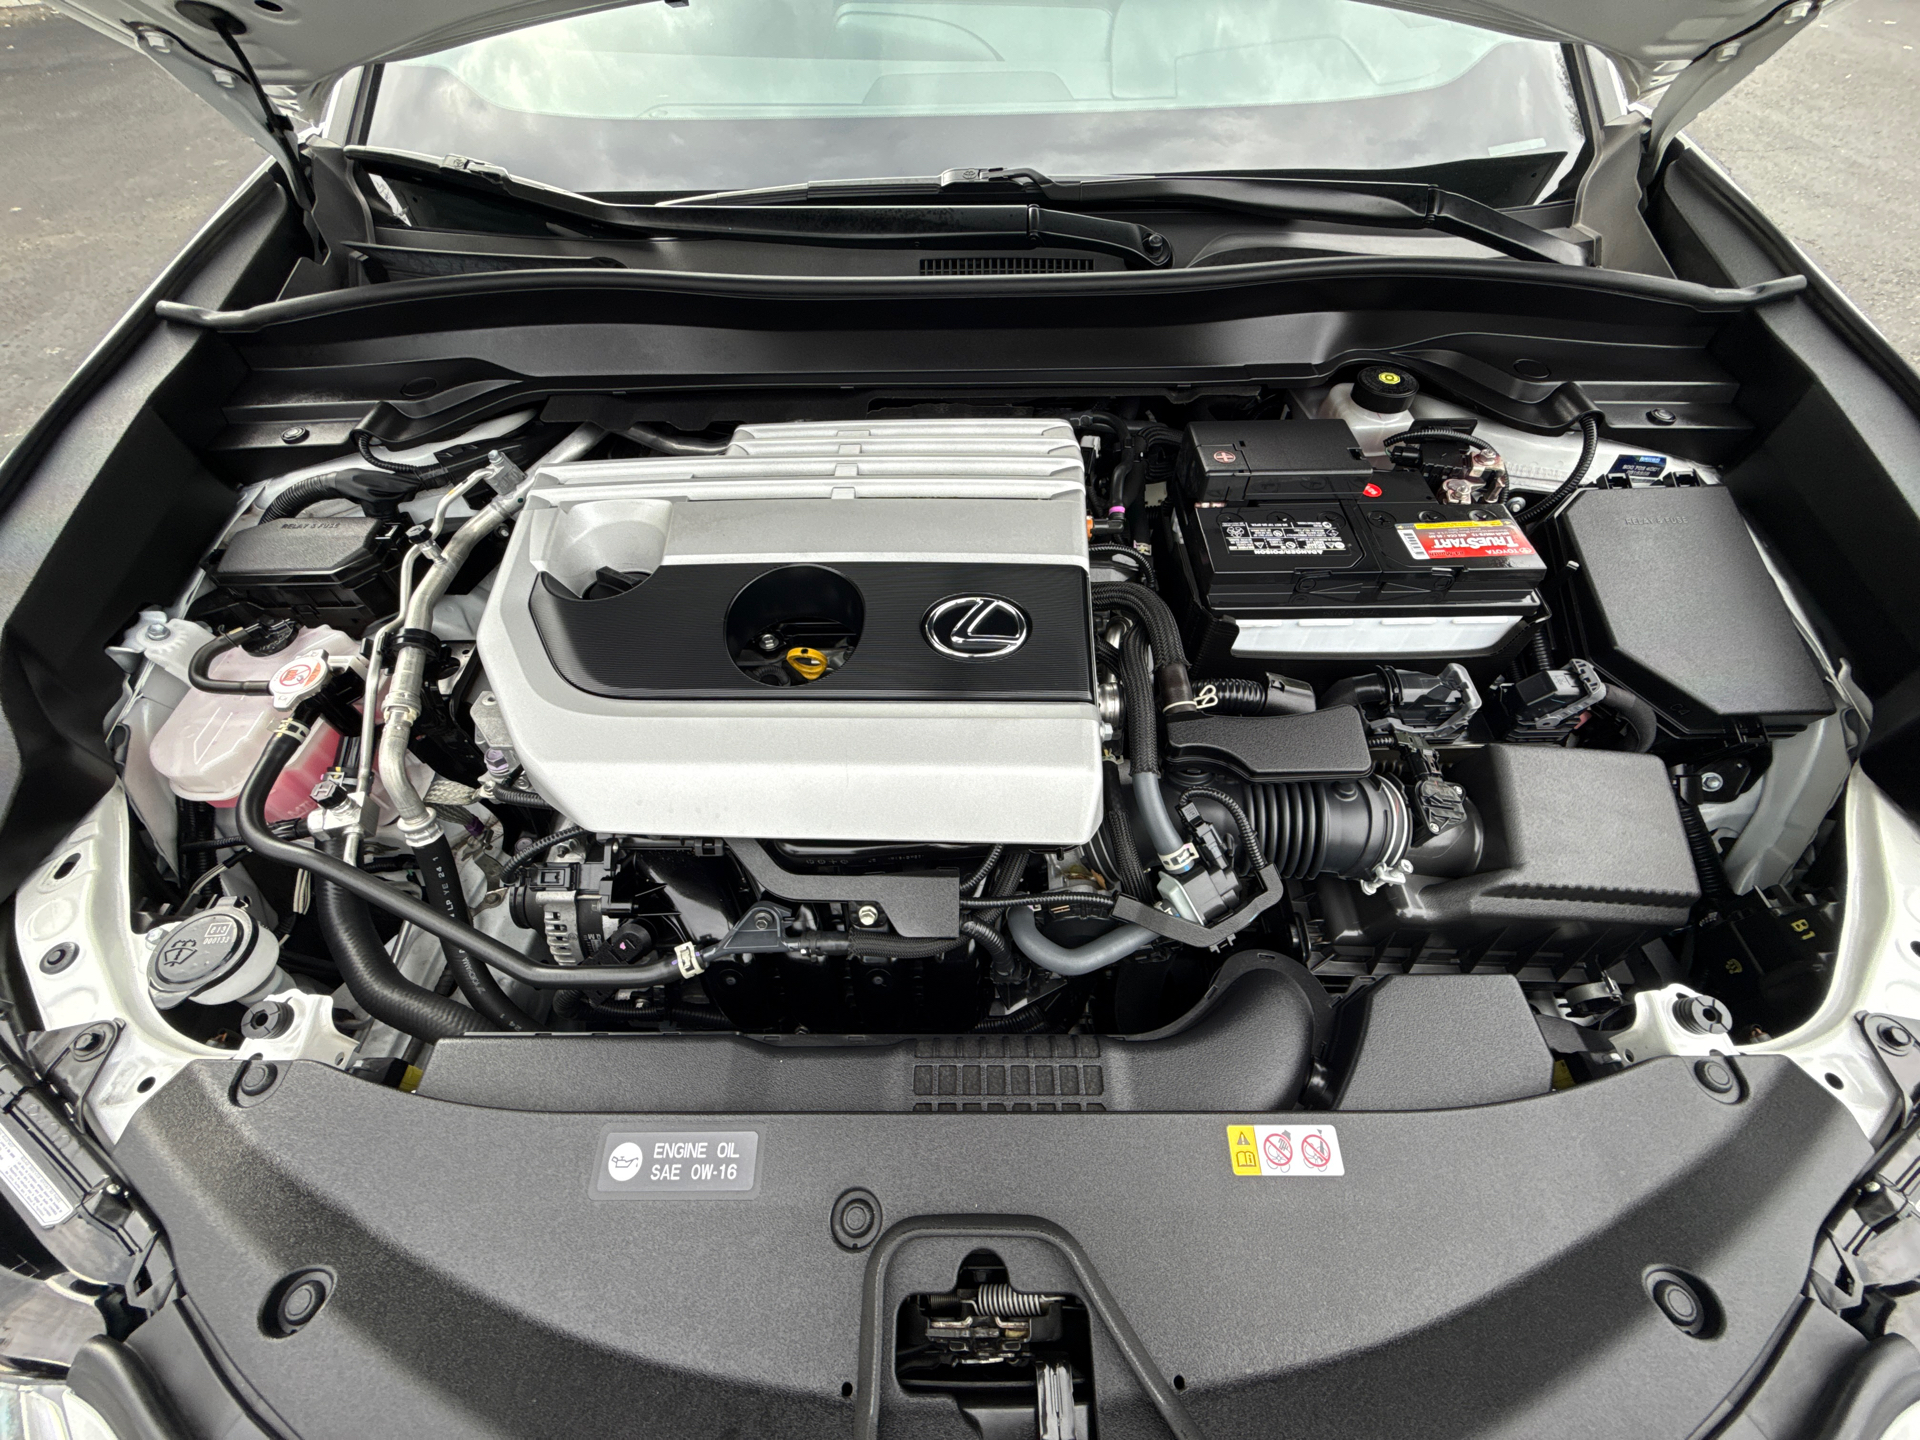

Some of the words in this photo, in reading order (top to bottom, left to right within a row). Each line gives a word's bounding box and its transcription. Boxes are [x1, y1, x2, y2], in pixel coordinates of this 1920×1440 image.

[1624, 517, 1654, 525] RELAY
[1664, 516, 1688, 524] FUSE
[436, 866, 445, 878] 24
[442, 882, 450, 896] YE
[446, 900, 455, 911] LP
[1790, 918, 1816, 940] B1
[462, 957, 481, 988] YOKOHAMA
[508, 1020, 522, 1031] 24
[653, 1142, 708, 1158] ENGINE
[716, 1142, 740, 1158] OIL
[650, 1164, 681, 1180] SAE
[690, 1164, 738, 1180] 0W-16
